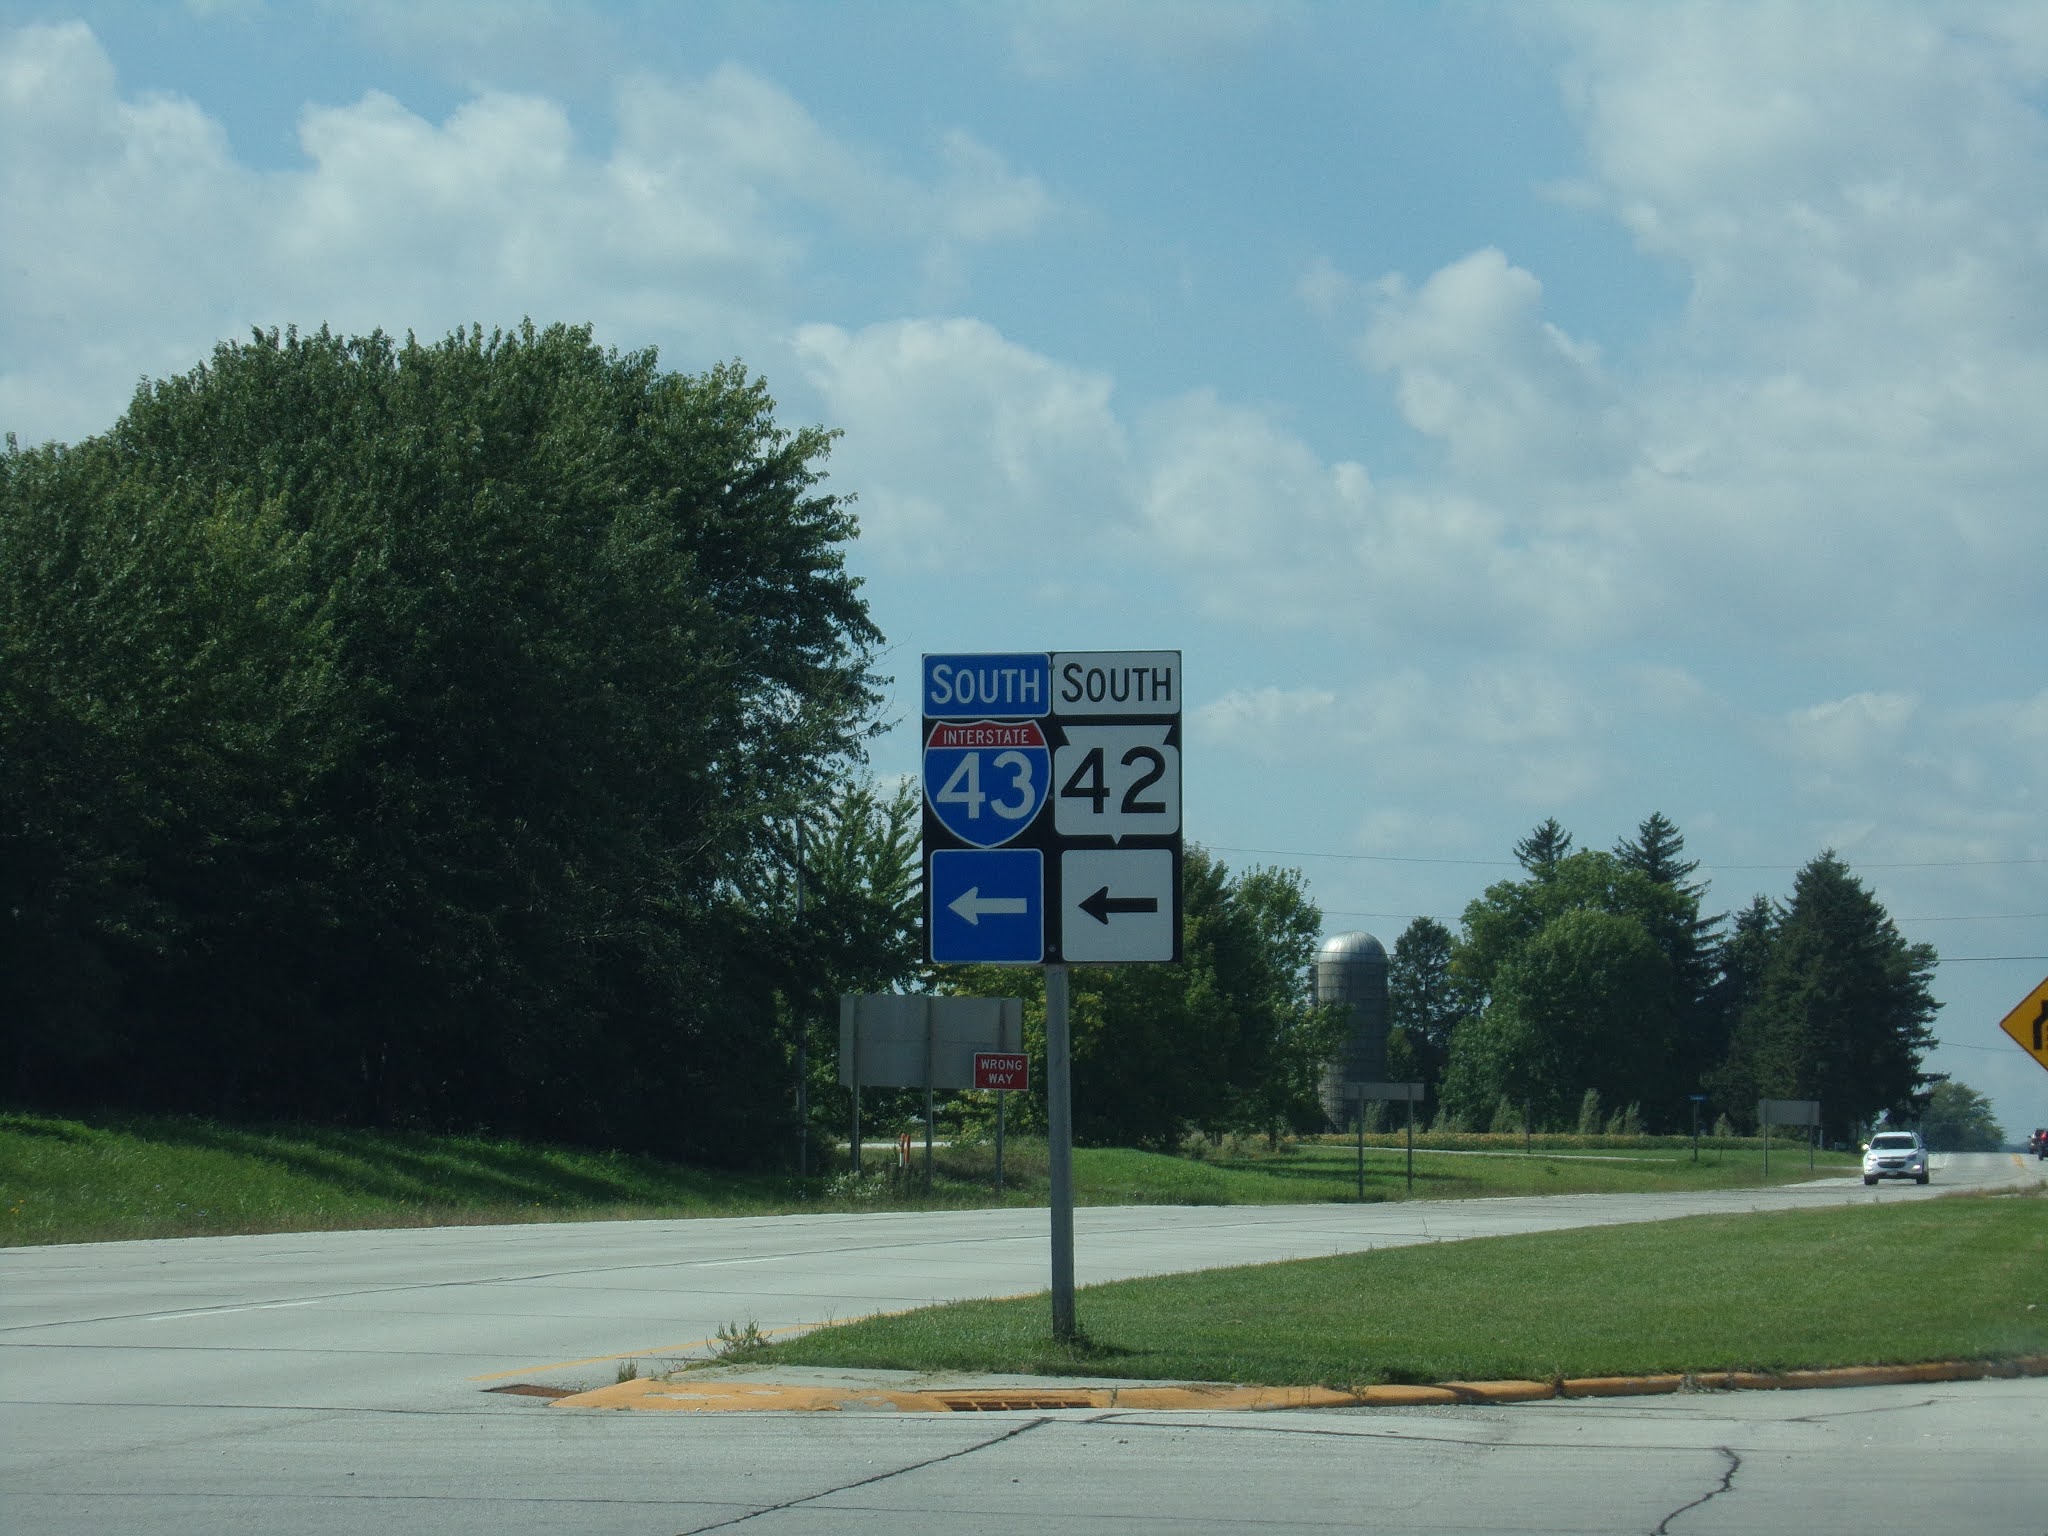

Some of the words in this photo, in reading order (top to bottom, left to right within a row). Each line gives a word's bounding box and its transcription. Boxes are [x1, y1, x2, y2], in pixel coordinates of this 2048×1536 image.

[931, 664, 1039, 704] SOUTH
[1061, 662, 1172, 703] SOUTH
[943, 729, 1029, 744] INTERSTATE
[936, 751, 1036, 820] 43
[1060, 746, 1167, 814] 42
[981, 1058, 1023, 1071] WRONG
[988, 1073, 1014, 1084] WAY
